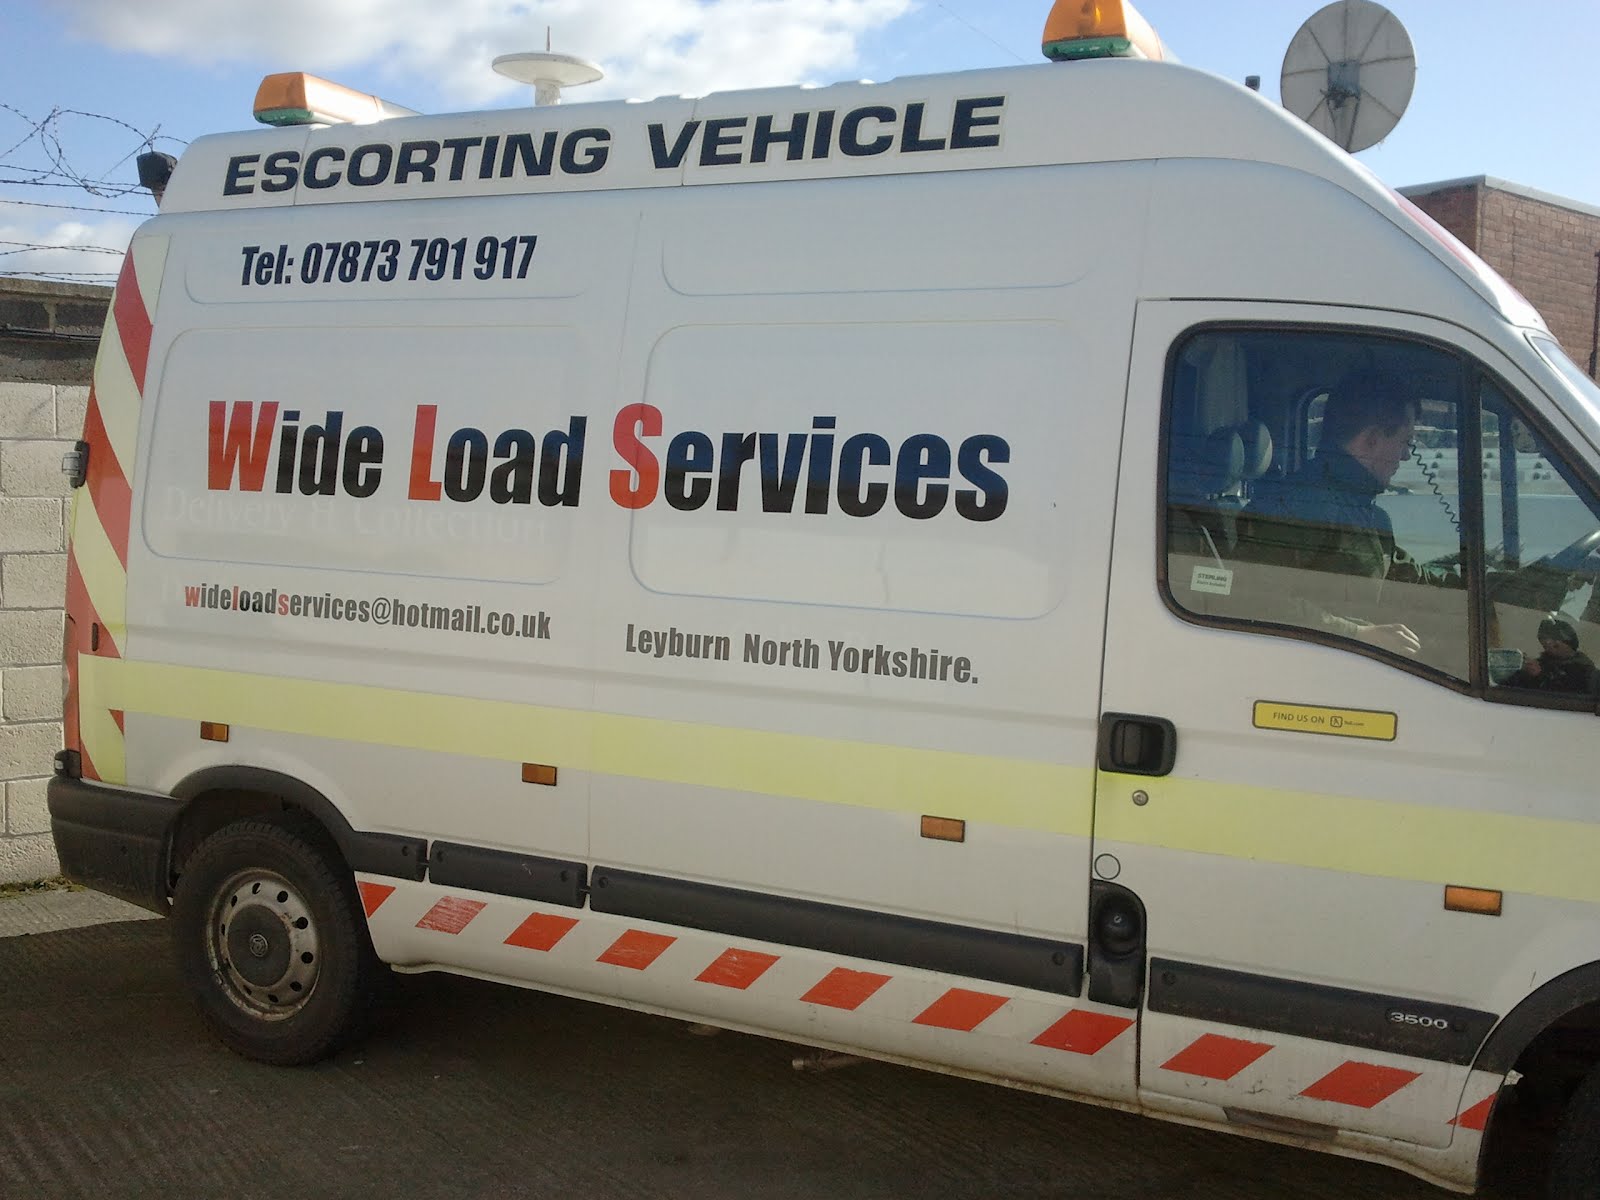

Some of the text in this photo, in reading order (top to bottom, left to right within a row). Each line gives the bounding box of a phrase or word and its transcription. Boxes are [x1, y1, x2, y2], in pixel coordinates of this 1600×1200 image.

[222, 96, 1006, 197] ESCORTING VEHICLE
[240, 235, 538, 286] Tel: 07873 791 917
[208, 401, 1011, 522] Wide Load Services
[184, 583, 552, 640] wideloadservices@hotmail.co.uk
[625, 624, 979, 685] Leyburn North Yorkshire.
[1272, 712, 1325, 724] FIND US ON
[1390, 1012, 1448, 1030] 3500
